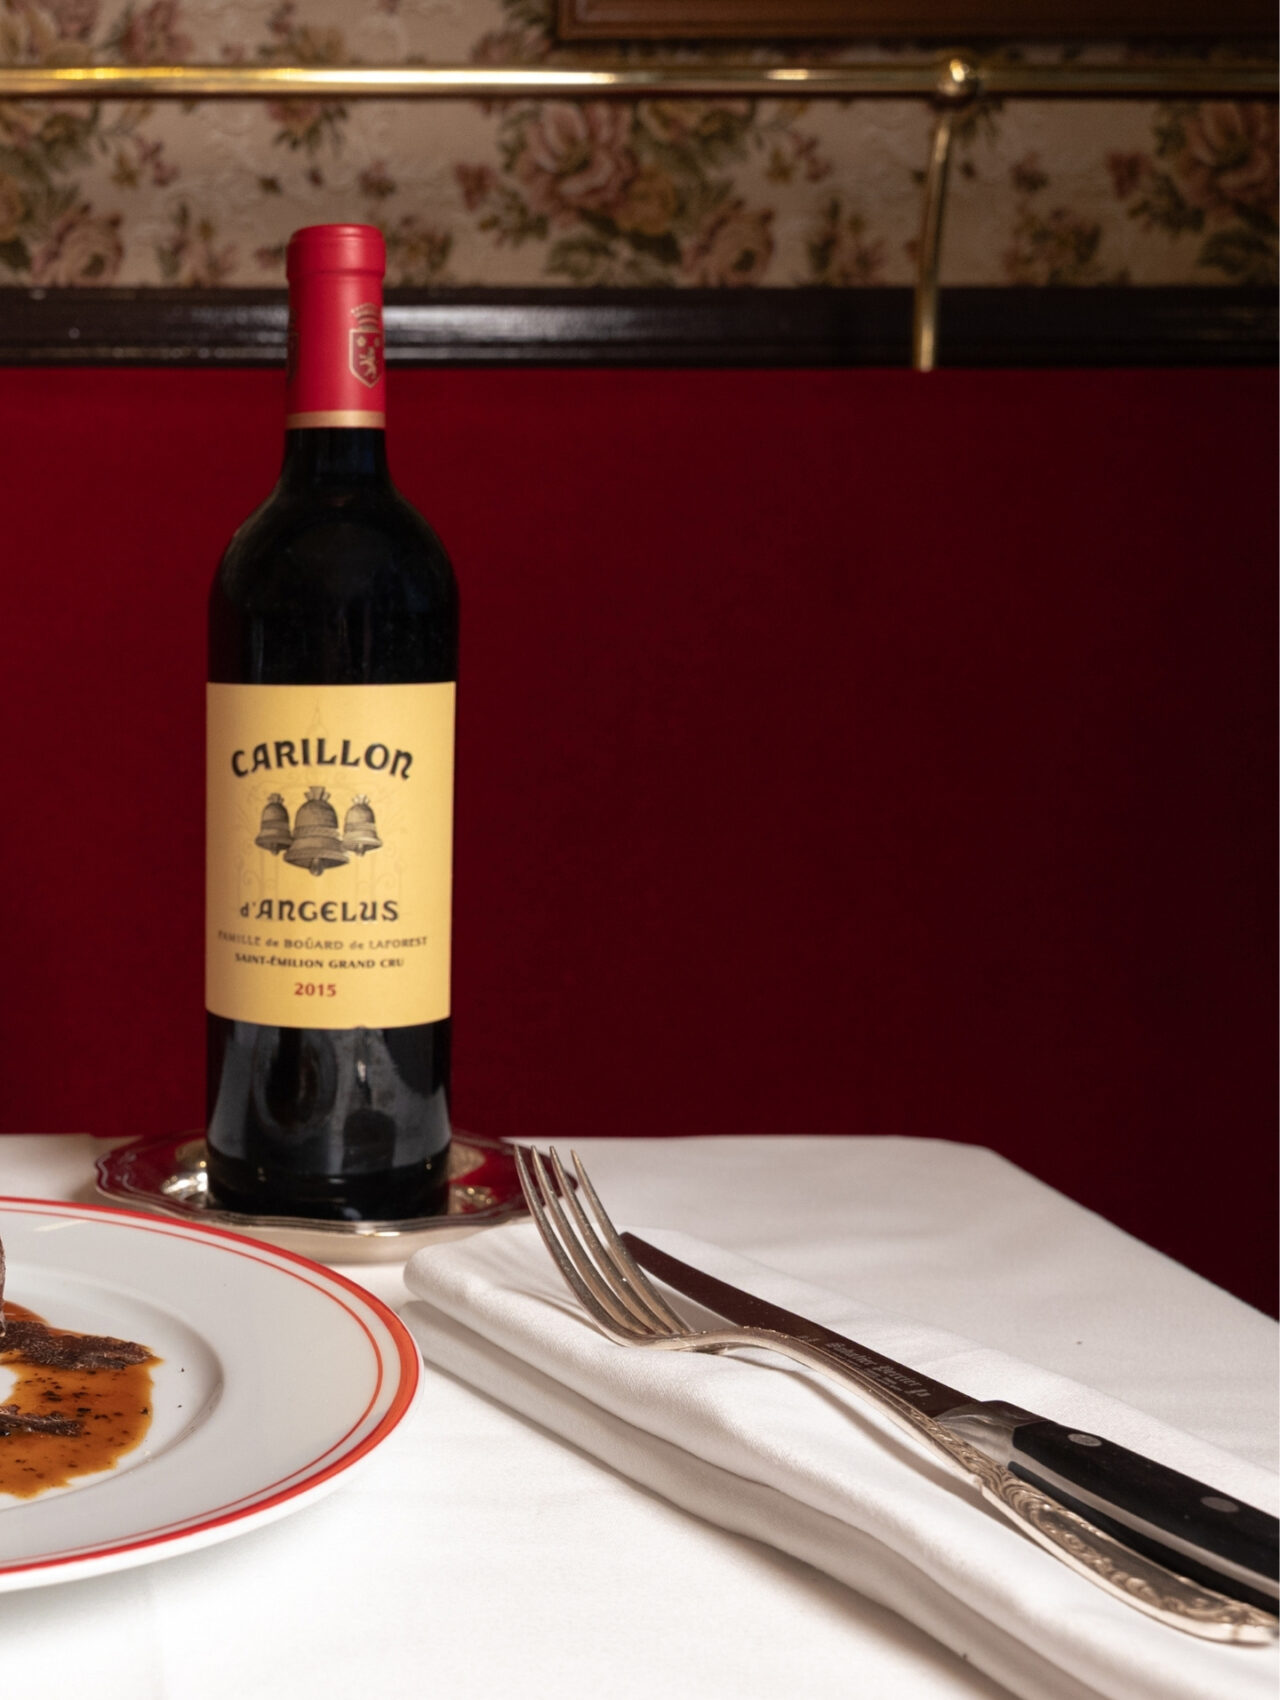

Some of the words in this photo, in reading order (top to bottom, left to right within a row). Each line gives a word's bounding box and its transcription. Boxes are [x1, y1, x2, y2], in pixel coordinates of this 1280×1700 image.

[231, 737, 413, 780] CARILLON
[239, 898, 399, 922] d'ANGELUS
[265, 938, 279, 948] de
[284, 937, 344, 950] BOÛARD
[349, 940, 364, 950] de
[369, 935, 428, 949] LAFOREST
[234, 952, 324, 969] SAINT-ÉMILION
[328, 959, 376, 969] GRAND
[380, 958, 405, 969] CRU
[294, 981, 337, 998] 2015
